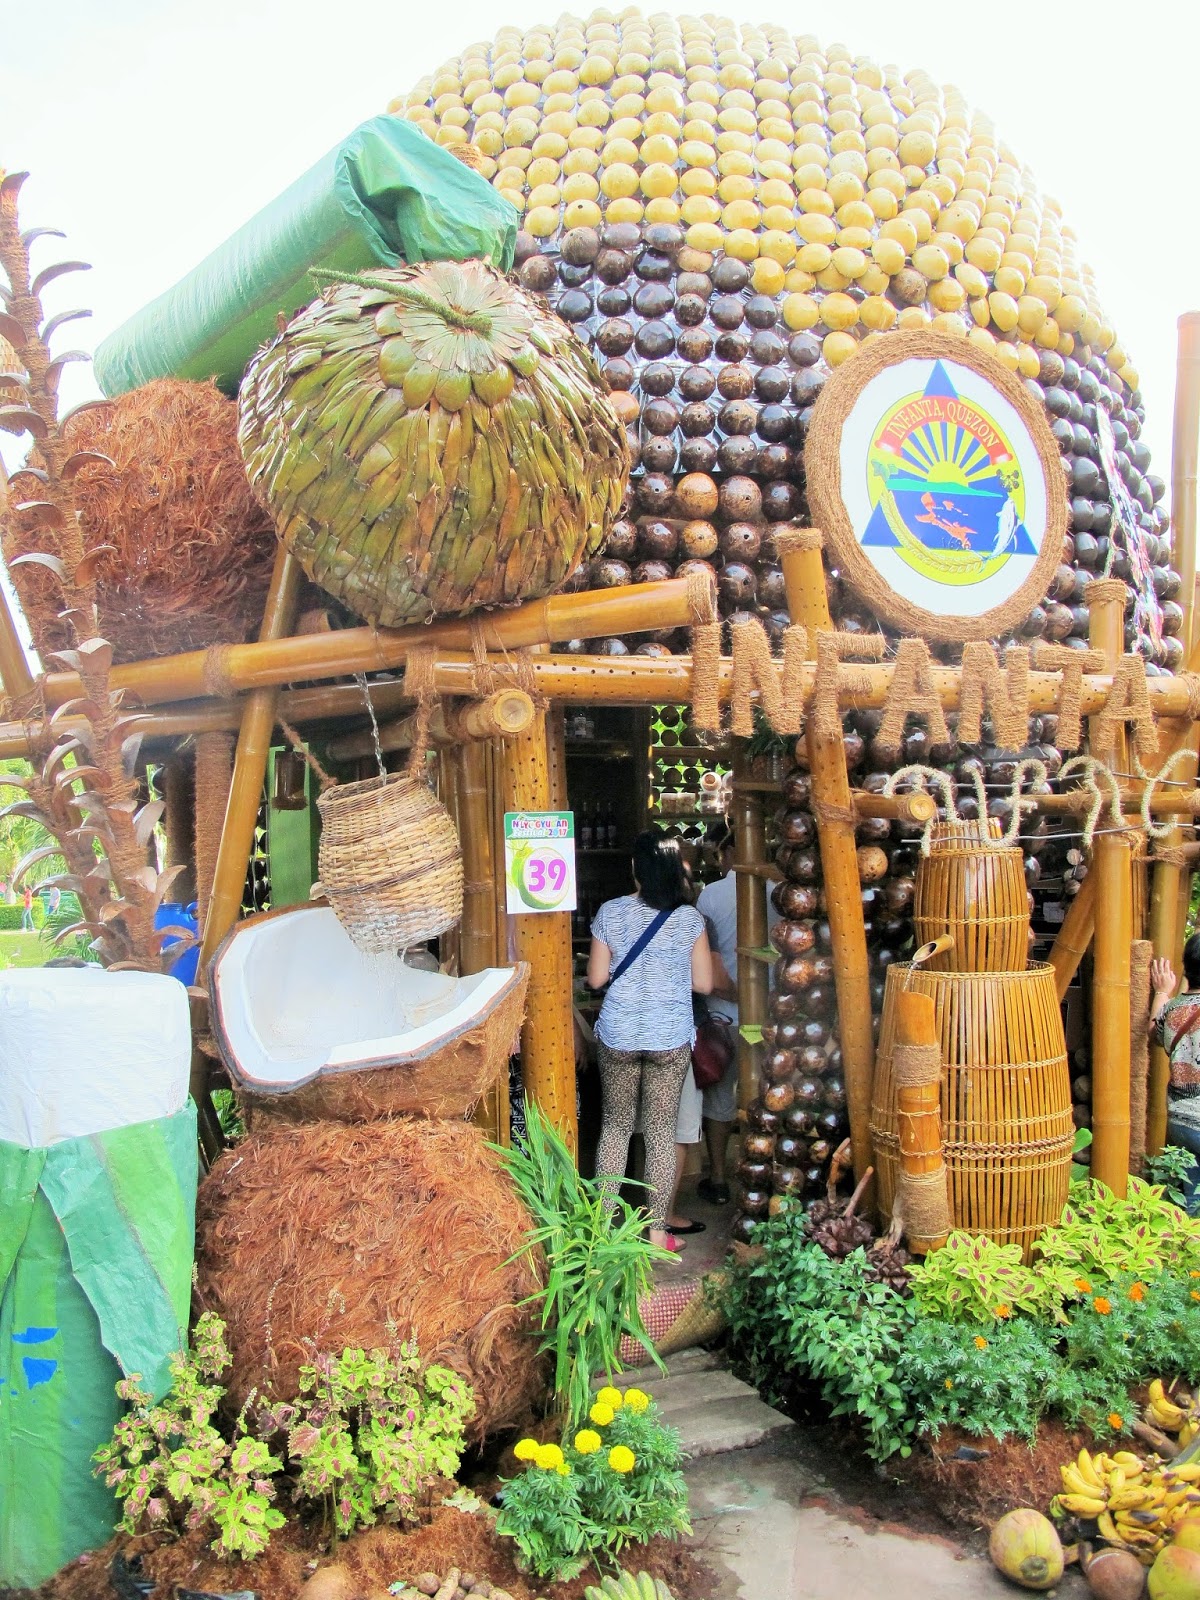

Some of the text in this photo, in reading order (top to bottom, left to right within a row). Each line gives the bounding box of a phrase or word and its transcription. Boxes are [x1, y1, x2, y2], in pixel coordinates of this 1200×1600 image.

[886, 399, 1001, 448] INFANTA, QUEZON
[691, 617, 1160, 753] INFANTA
[548, 828, 568, 837] 2017
[528, 858, 567, 892] 39
